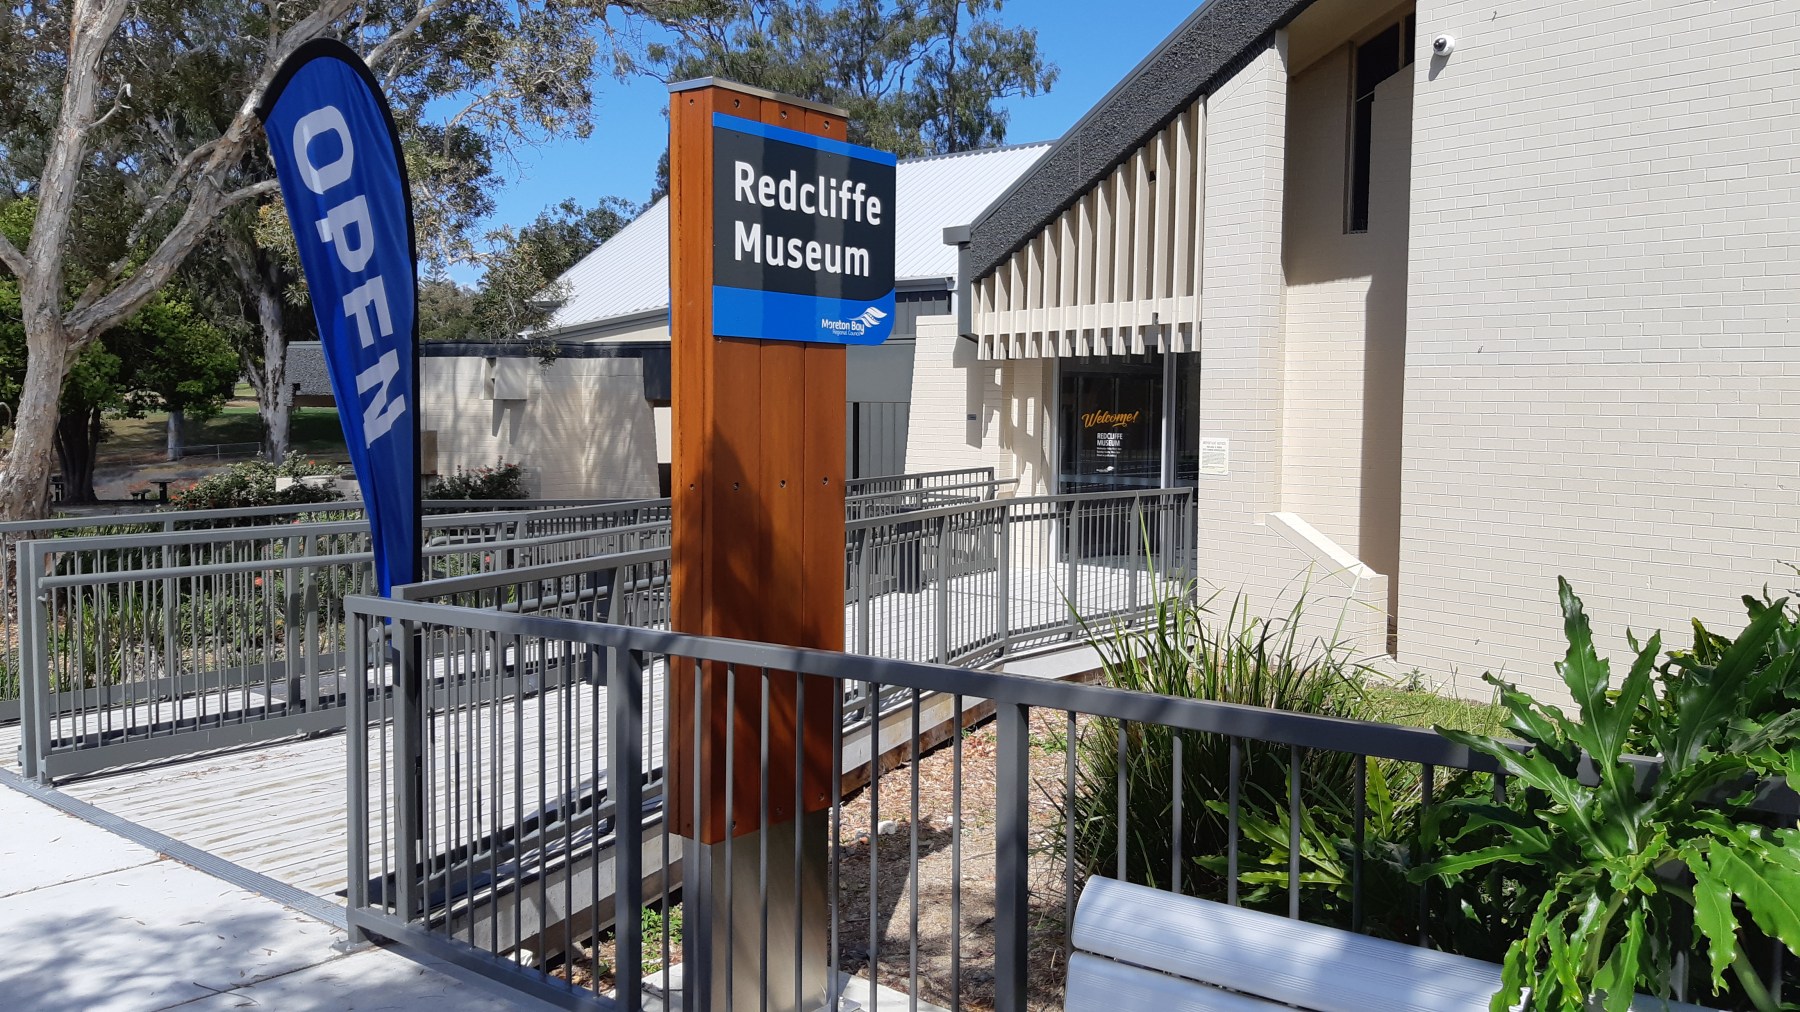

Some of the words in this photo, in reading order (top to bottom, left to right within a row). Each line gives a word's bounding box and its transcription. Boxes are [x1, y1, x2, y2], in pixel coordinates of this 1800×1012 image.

[734, 160, 881, 226] Redcliffe
[734, 220, 869, 277] Museum
[821, 318, 850, 330] Moreton
[851, 320, 865, 335] Bay
[1081, 409, 1139, 428] Welcome!
[1096, 432, 1123, 440] REDCLIFFE
